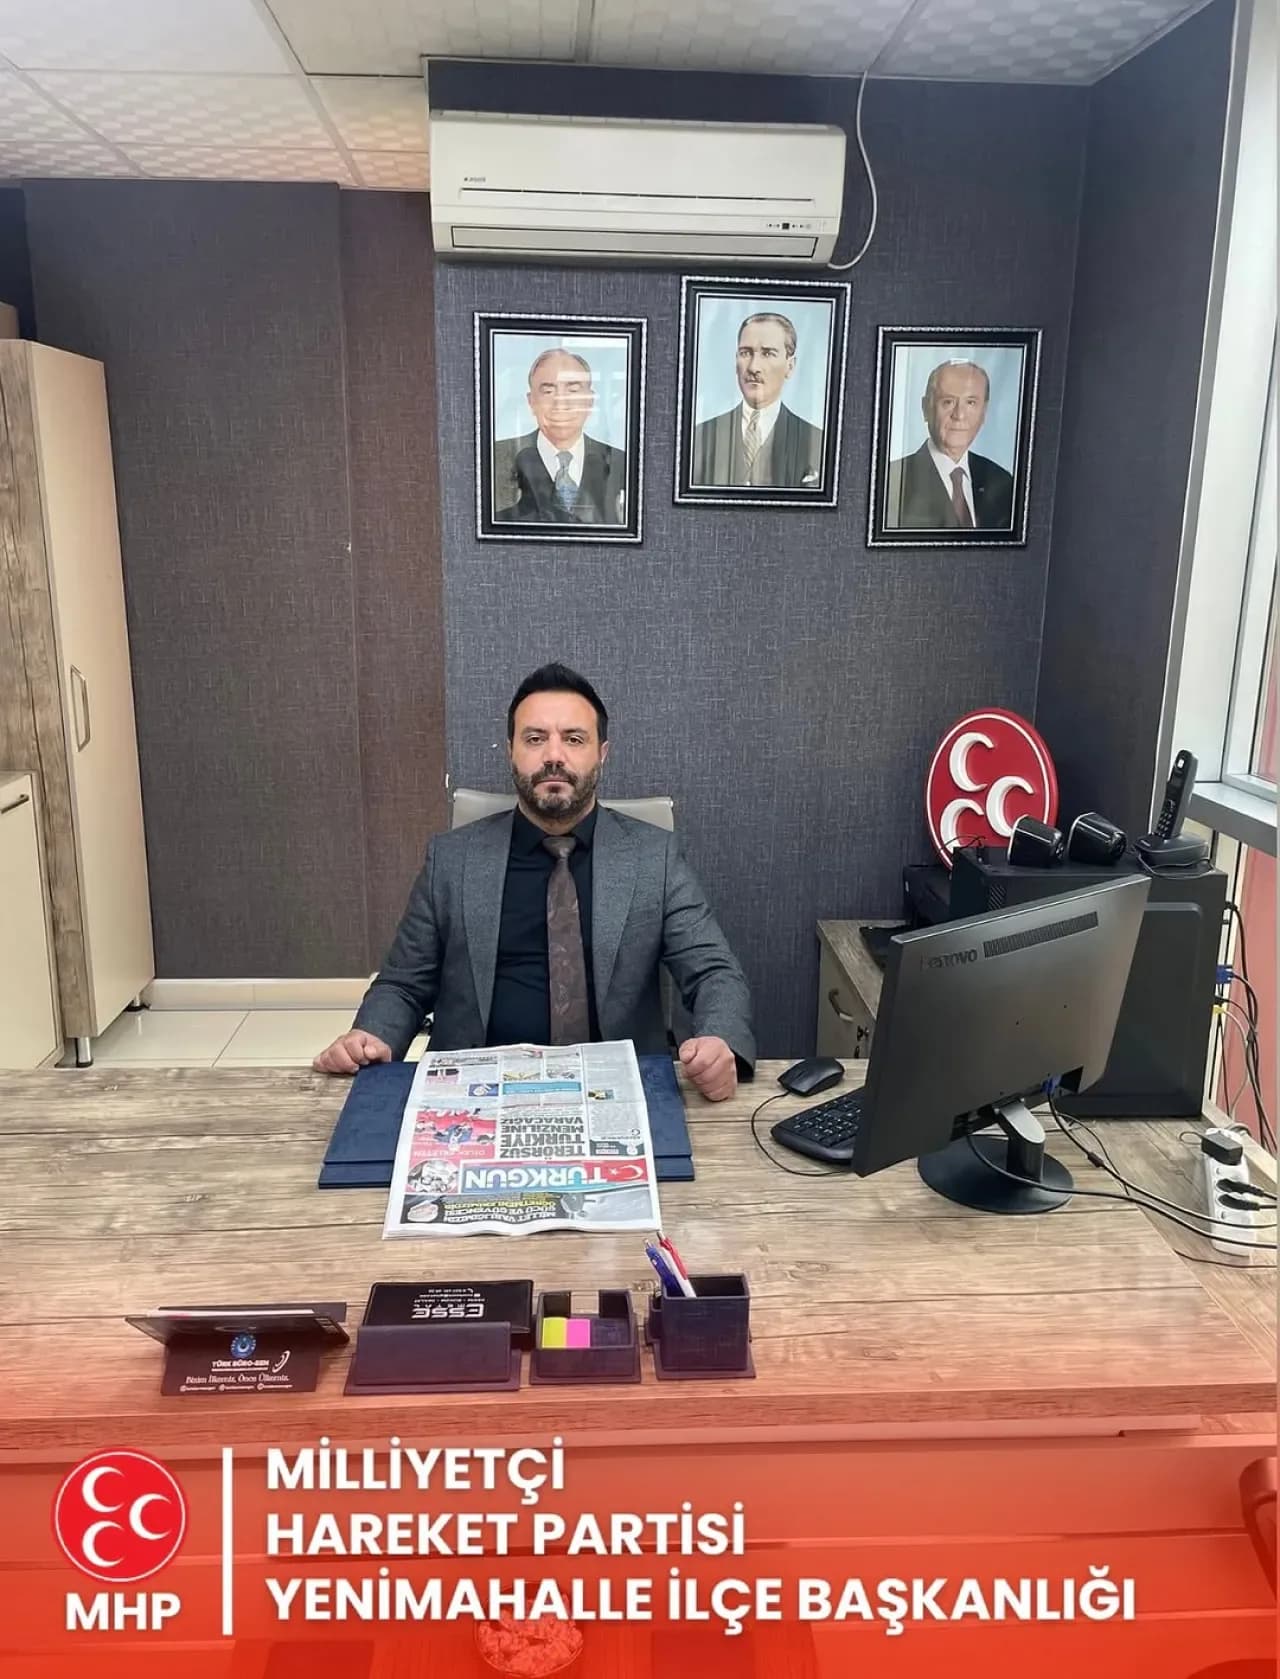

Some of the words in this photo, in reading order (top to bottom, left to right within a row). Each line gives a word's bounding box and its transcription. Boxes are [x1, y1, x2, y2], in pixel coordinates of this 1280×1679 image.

[500, 1133, 586, 1148] TÜRKİYE
[499, 1145, 587, 1160] TERÖRSÜZ
[465, 1166, 608, 1190] TÜRKGÜN
